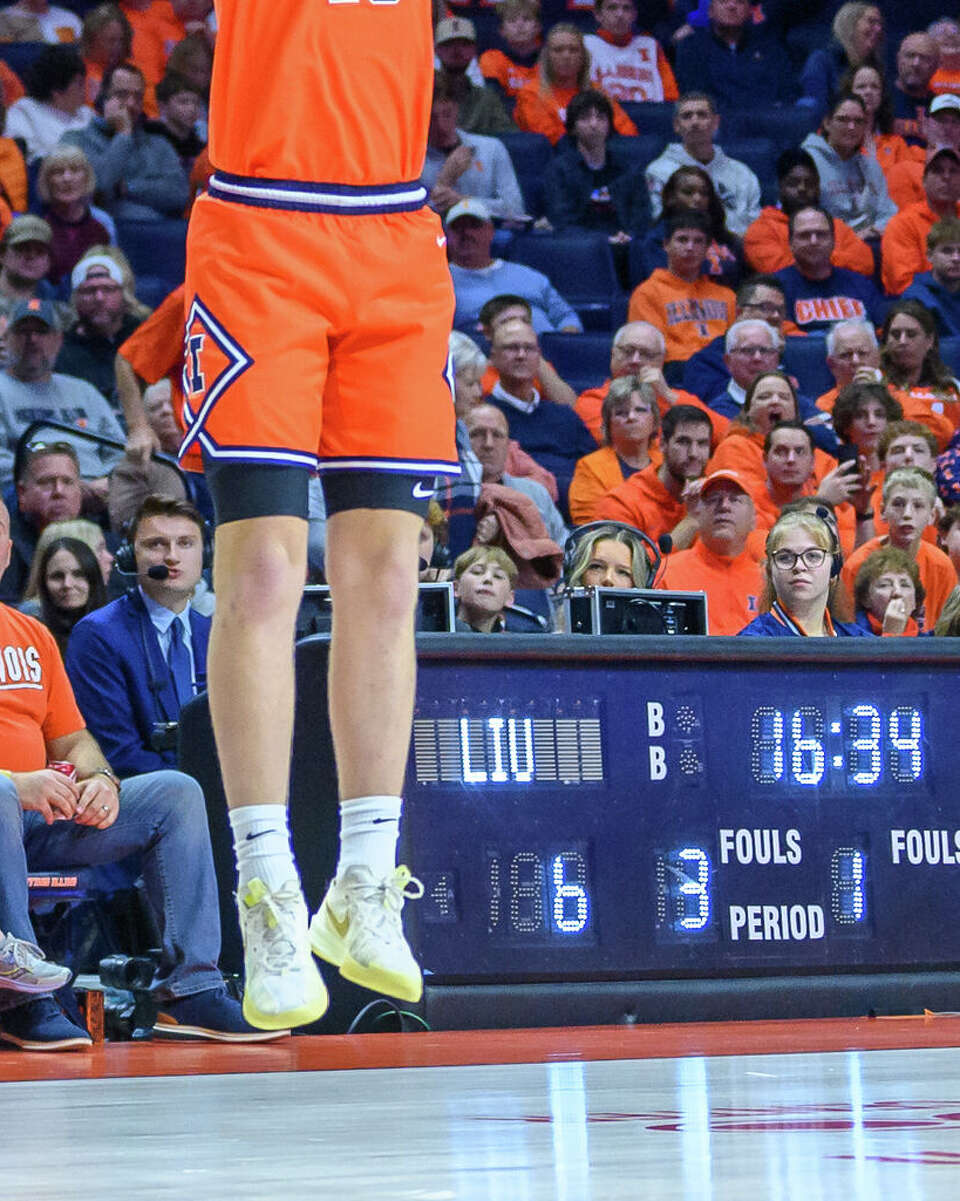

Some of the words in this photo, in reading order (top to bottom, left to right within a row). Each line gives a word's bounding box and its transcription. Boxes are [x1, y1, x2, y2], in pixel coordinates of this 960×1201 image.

[647, 701, 666, 737] B
[460, 717, 534, 783] LIU
[649, 745, 668, 781] B
[720, 828, 803, 865] FOULS
[729, 904, 825, 941] PERIOD
